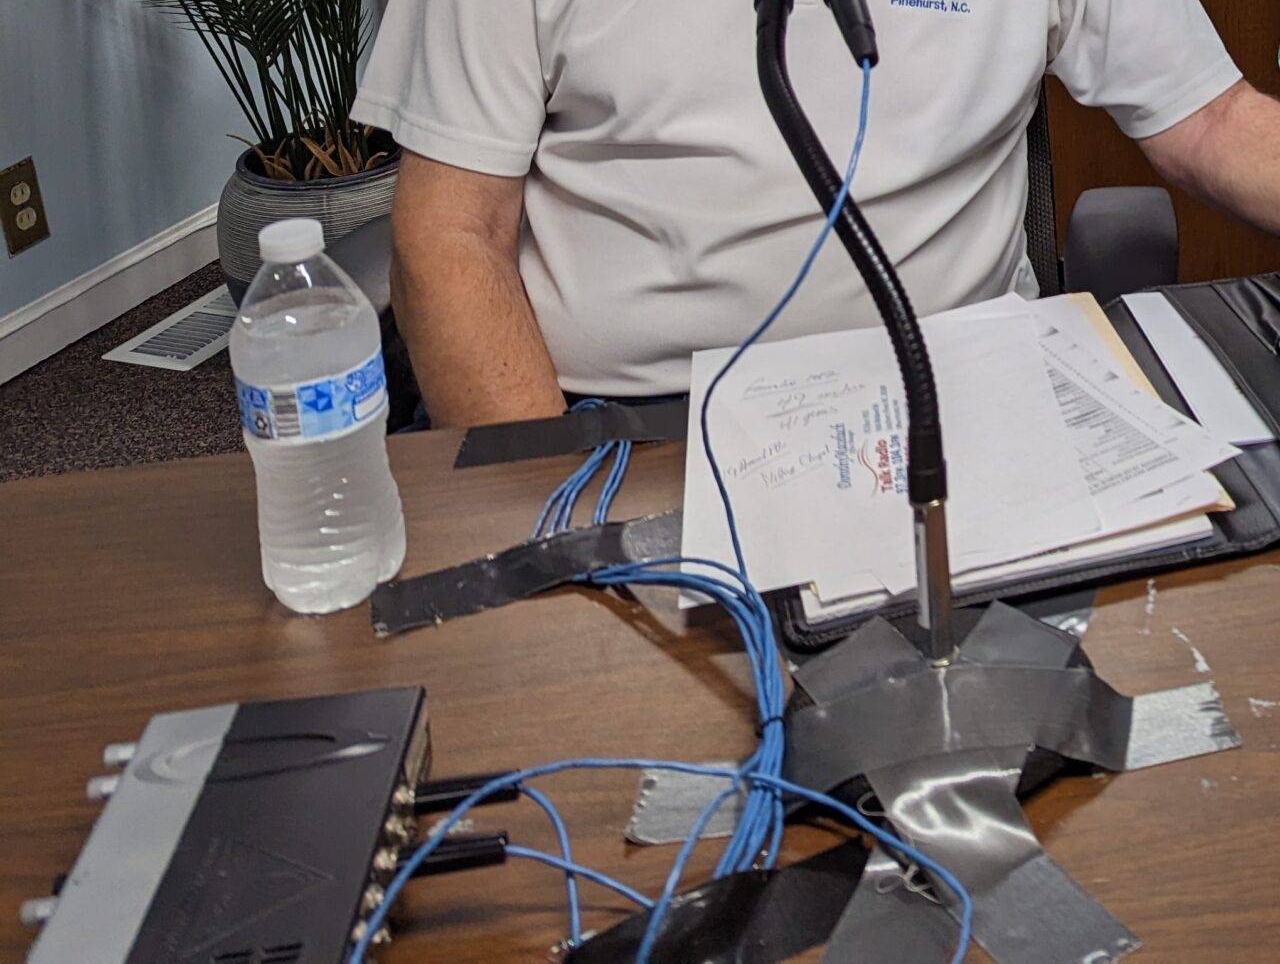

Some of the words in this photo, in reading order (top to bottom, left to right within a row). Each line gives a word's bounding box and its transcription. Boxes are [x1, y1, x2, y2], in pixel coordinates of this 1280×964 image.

[950, 1, 971, 13] N.C.
[876, 439, 889, 468] Radio
[879, 469, 893, 493] Talk
